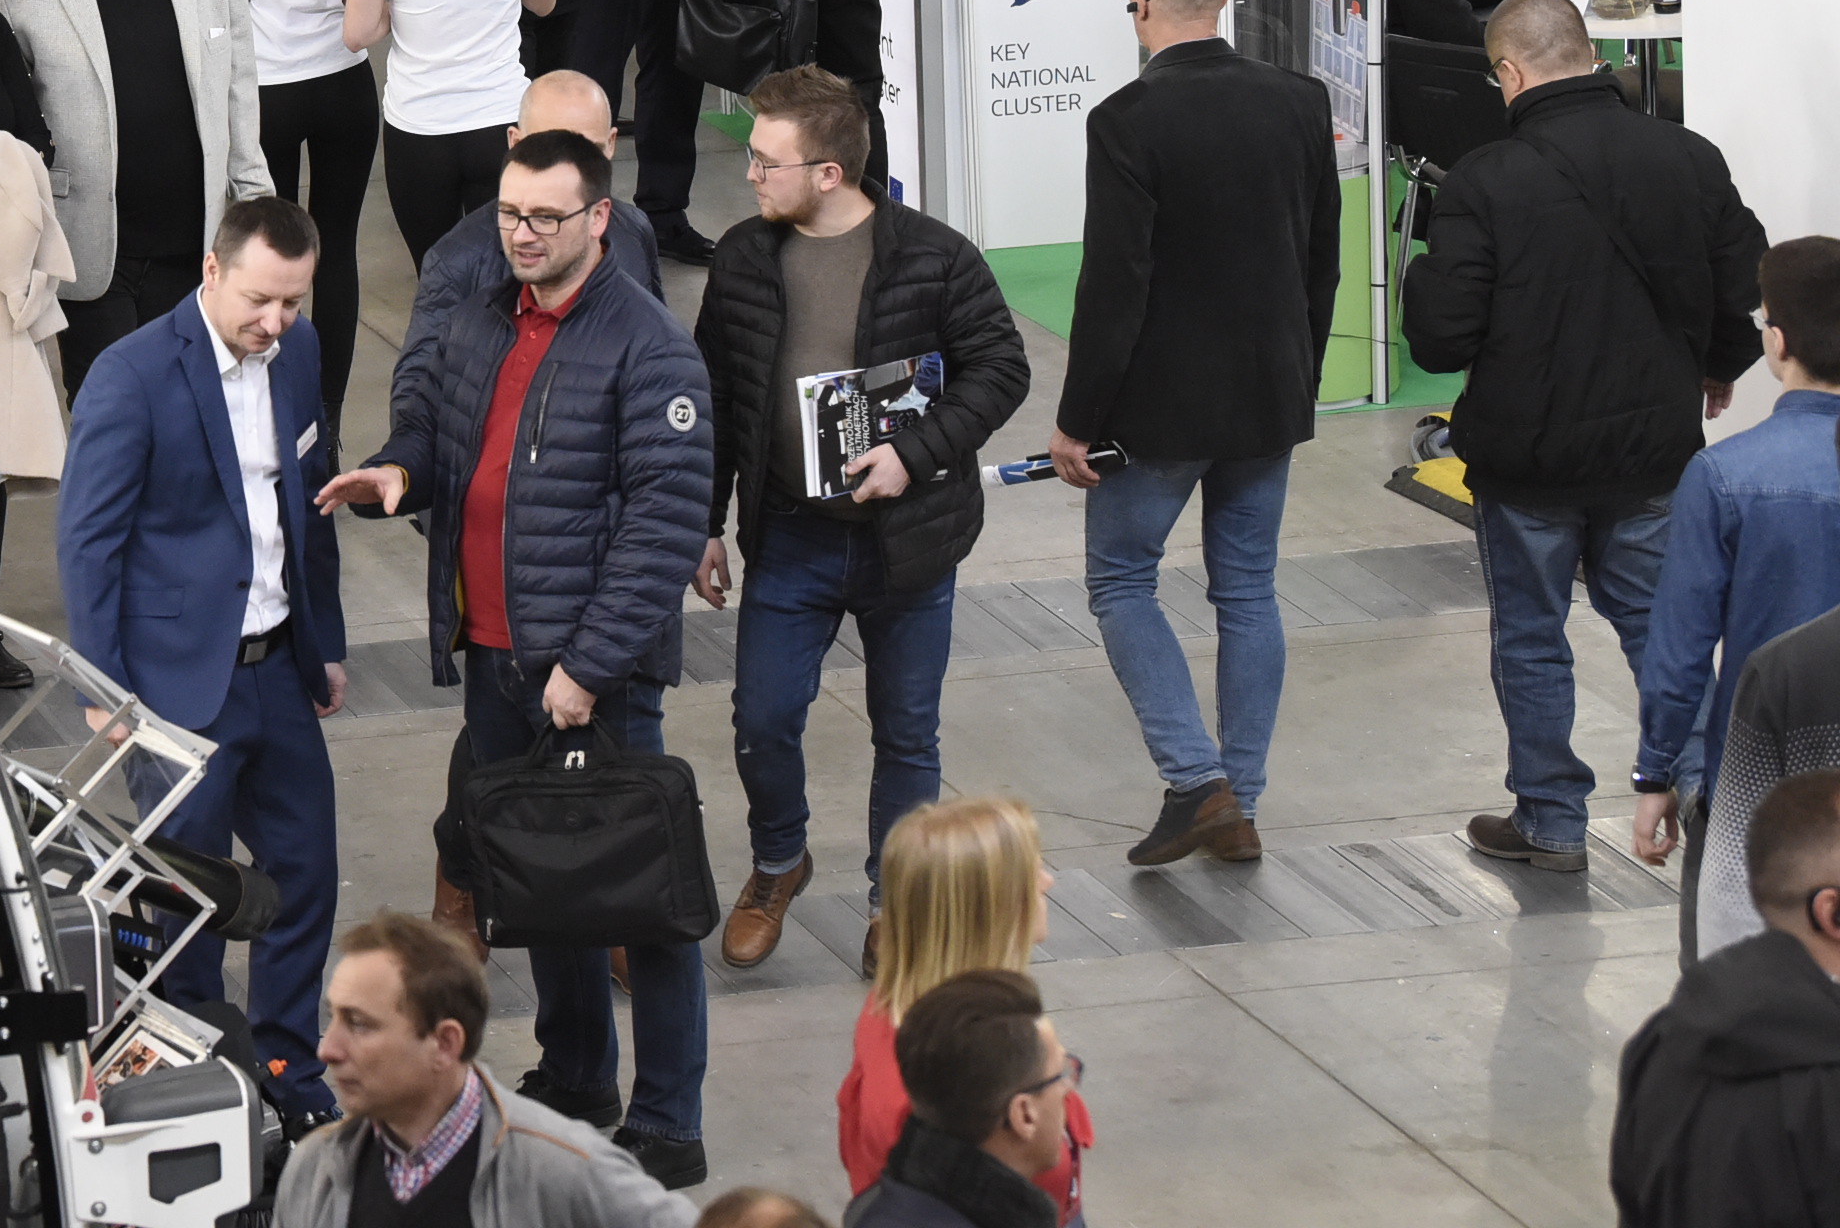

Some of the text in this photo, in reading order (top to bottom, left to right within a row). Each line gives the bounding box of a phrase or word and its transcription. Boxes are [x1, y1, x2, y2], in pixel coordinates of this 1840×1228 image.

[990, 42, 1031, 63] KEY
[991, 64, 1097, 90] NATIONAL
[991, 93, 1082, 117] CLUSTER
[676, 407, 689, 421] 27
[852, 390, 864, 460] ULTIMETRACH
[861, 395, 871, 452] YFROWYCH
